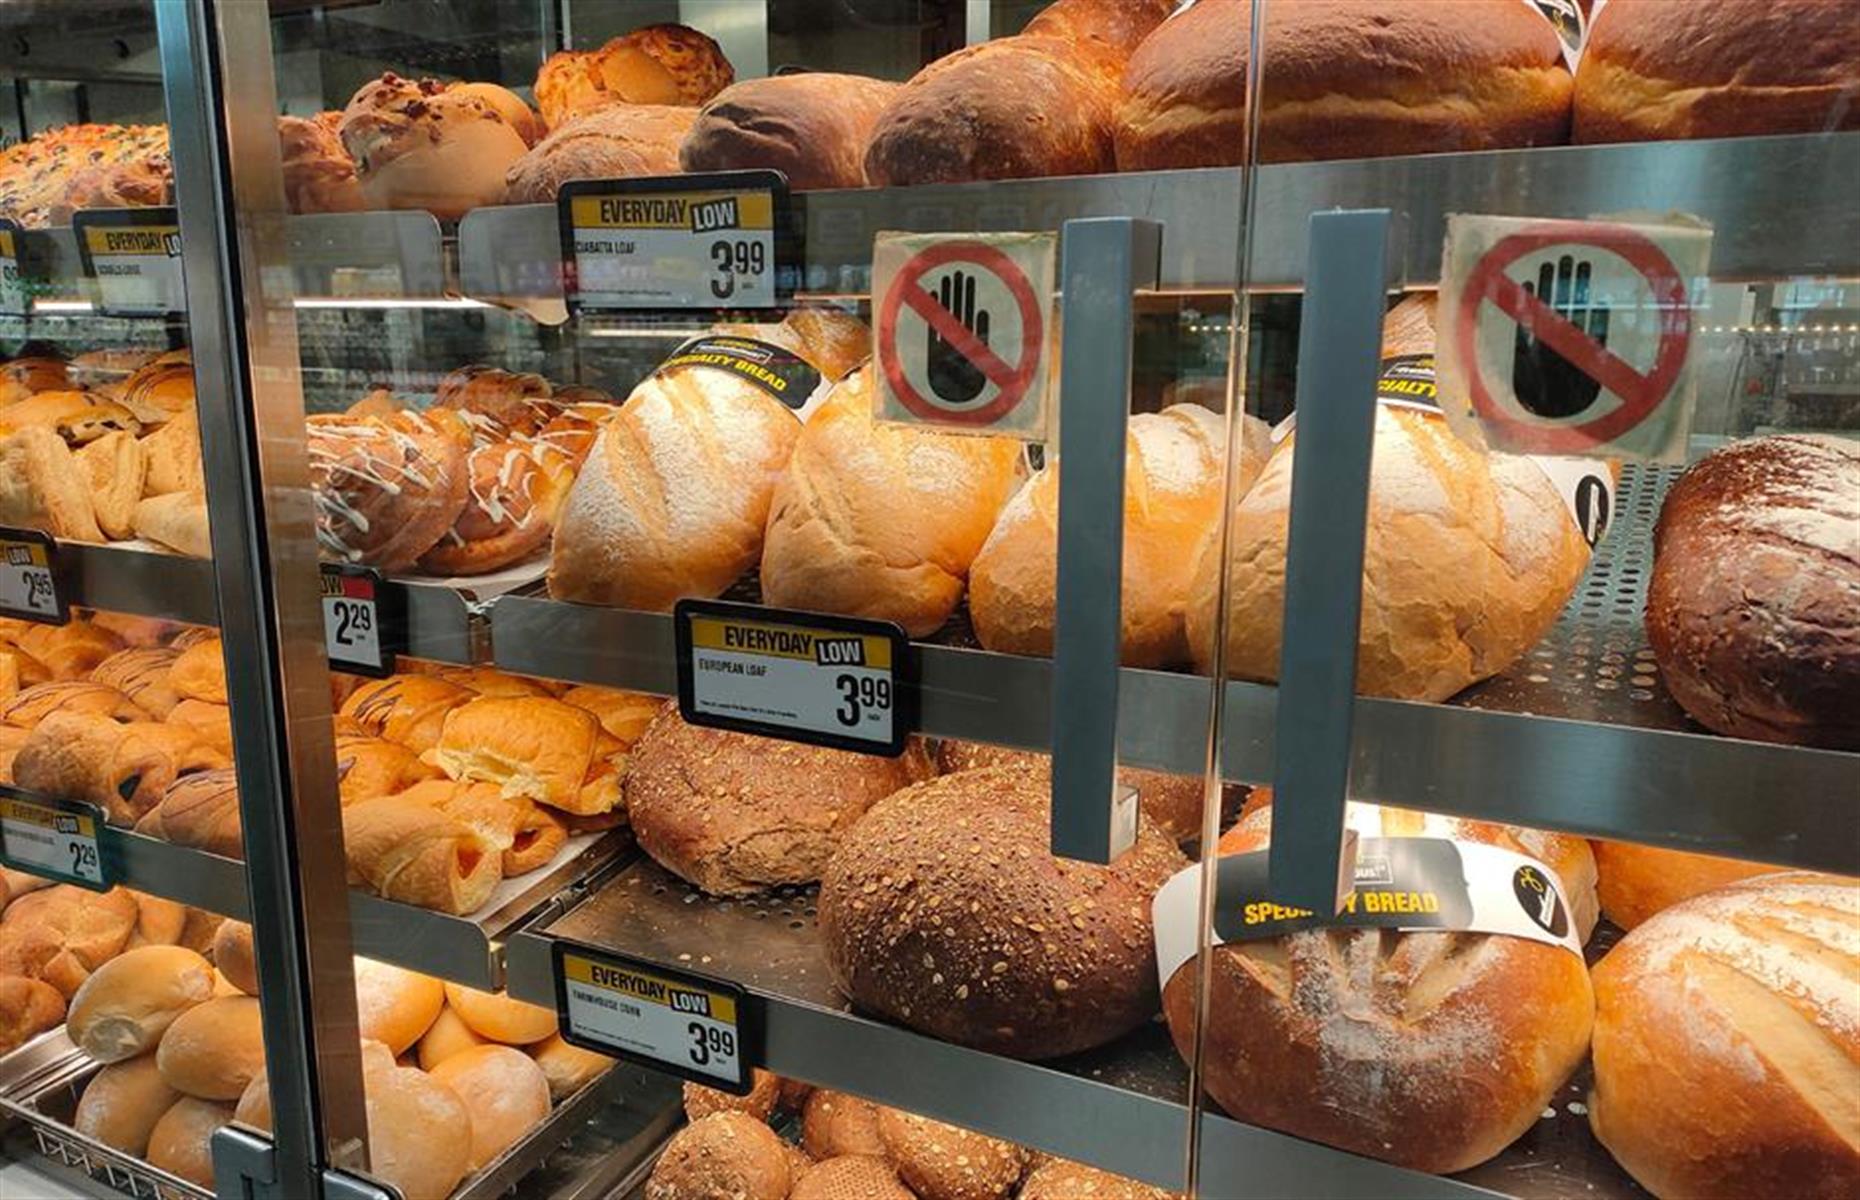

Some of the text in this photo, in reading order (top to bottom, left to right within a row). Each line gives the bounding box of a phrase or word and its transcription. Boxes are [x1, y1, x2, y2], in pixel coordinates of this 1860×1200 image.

[601, 199, 736, 230] EVERYDAY LOW
[105, 232, 181, 254] EVERYDAY LO
[735, 360, 787, 391] BREAD
[725, 625, 862, 664] EVERYDAY LOW
[699, 658, 768, 677] EUROPEAN LOAF
[1244, 890, 1439, 925] SPECY BREAD
[591, 966, 708, 1014] EVERYDAY LOW
